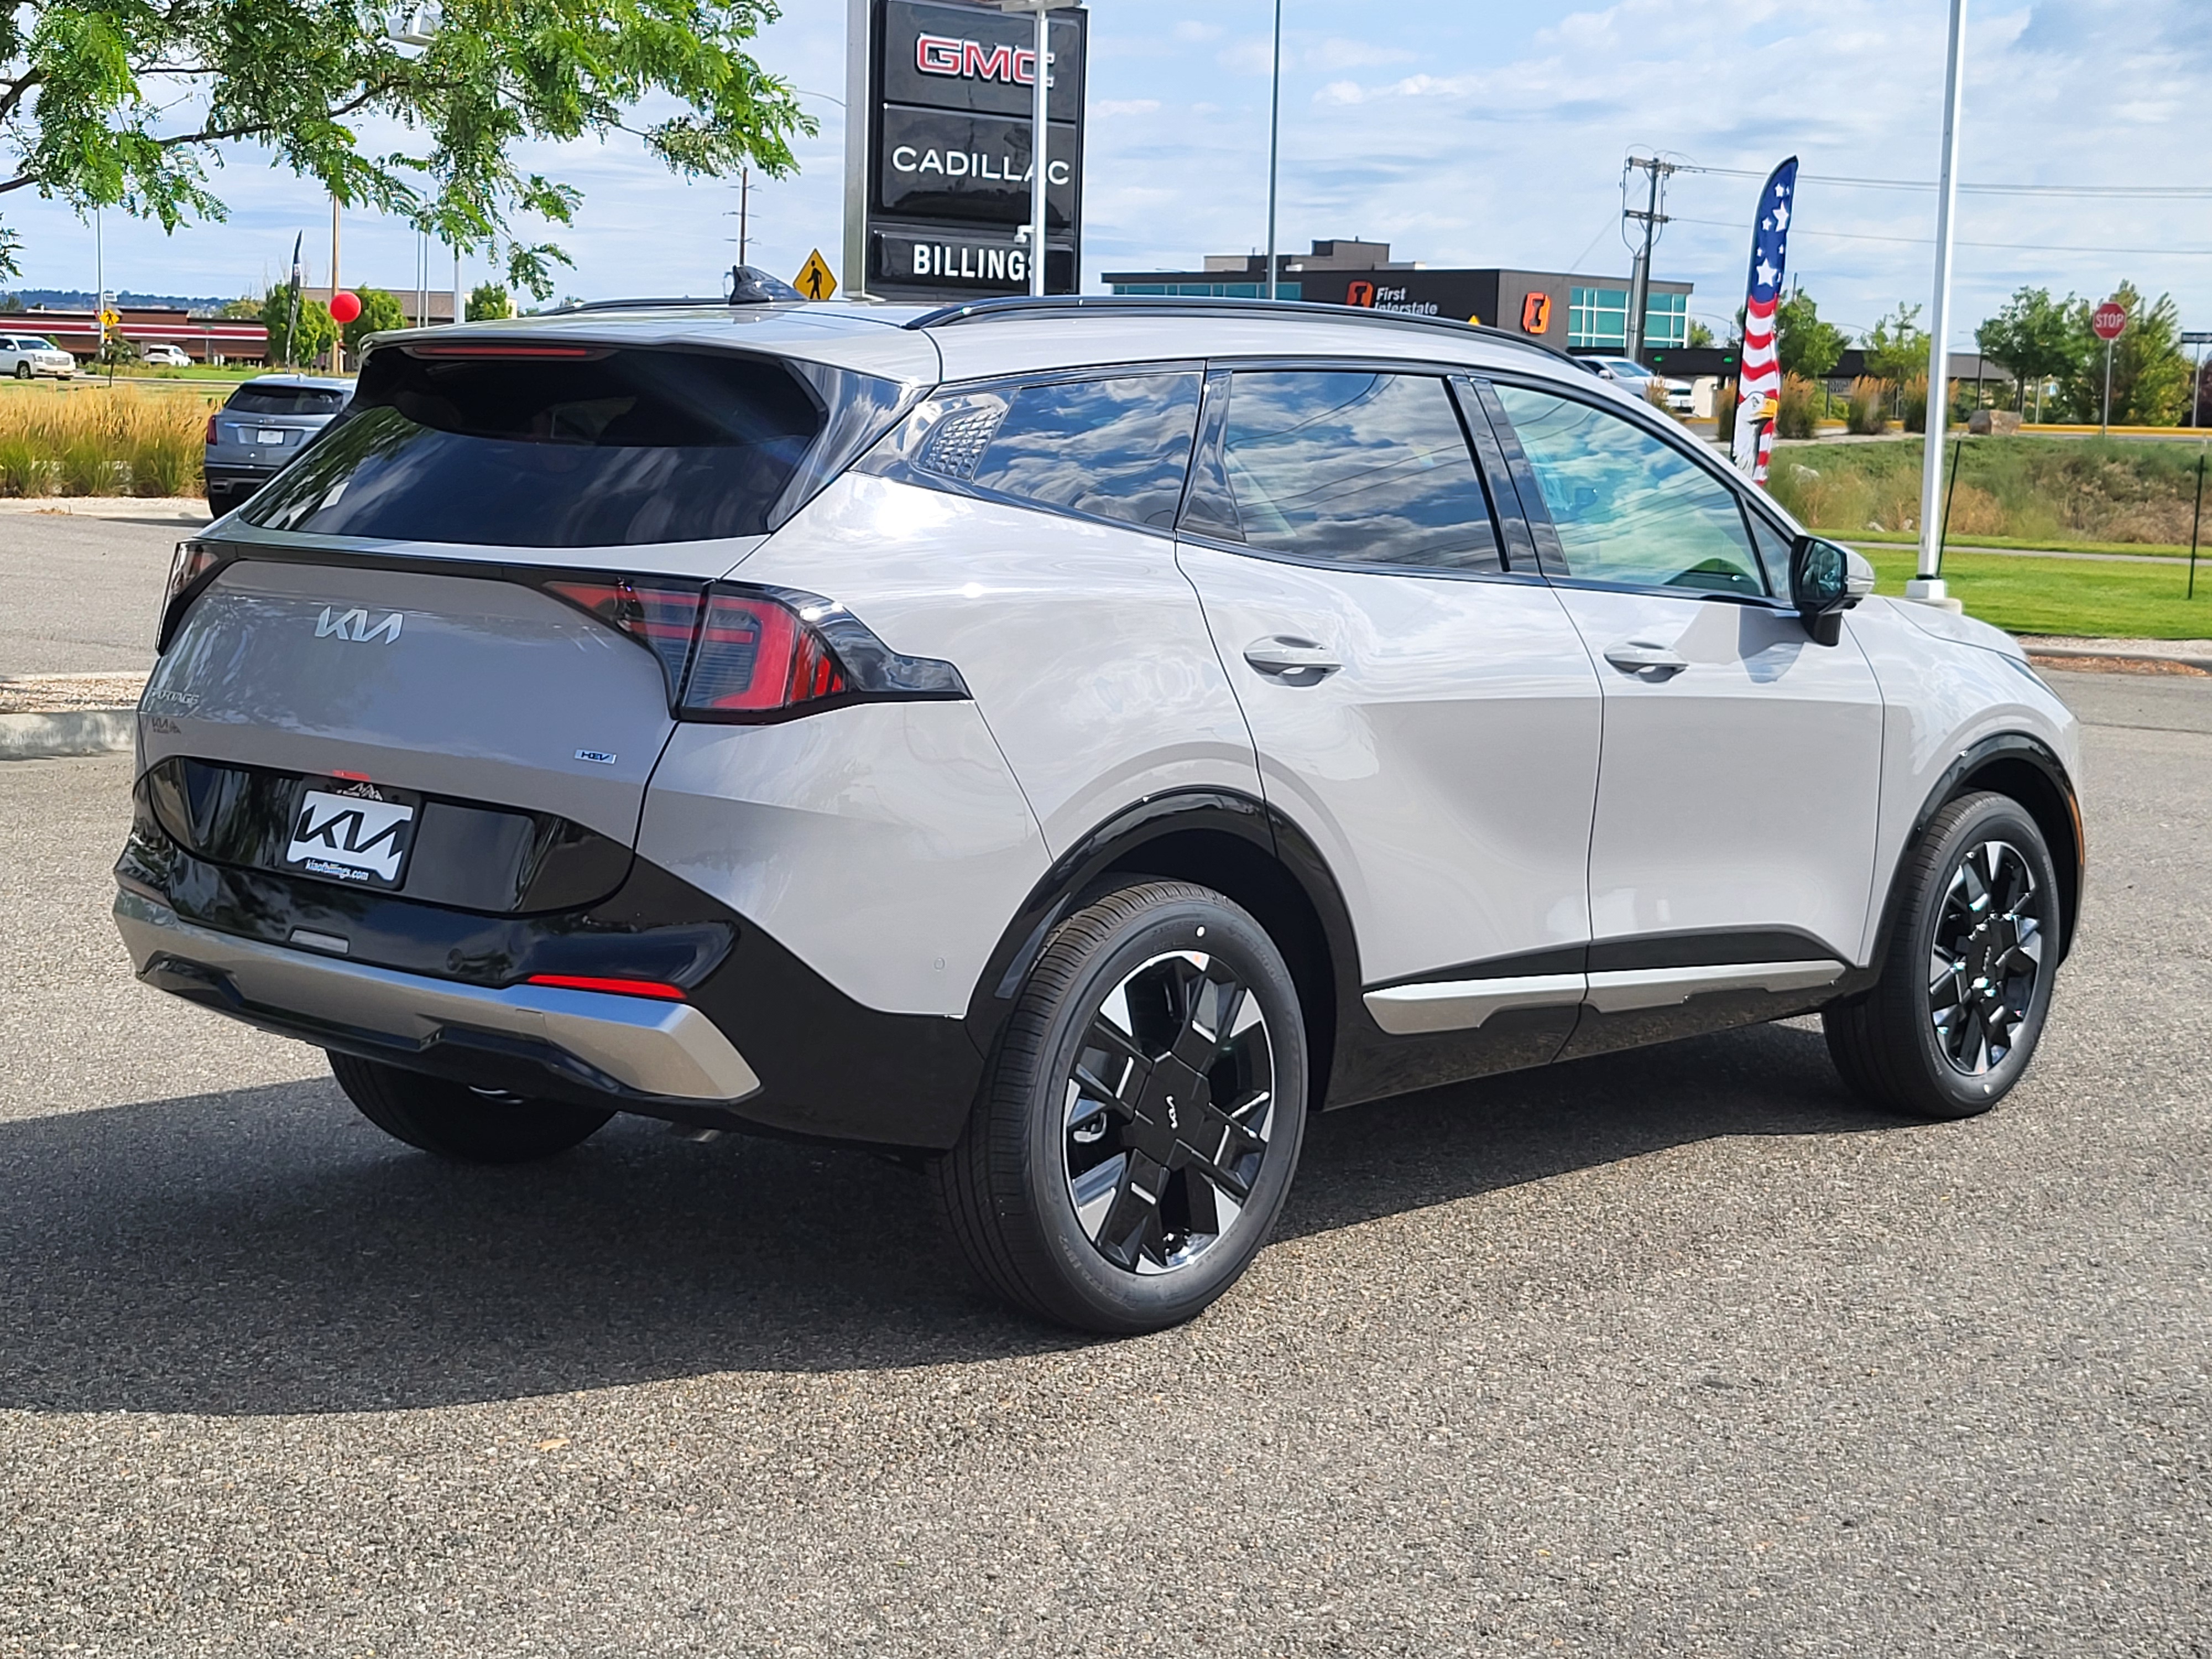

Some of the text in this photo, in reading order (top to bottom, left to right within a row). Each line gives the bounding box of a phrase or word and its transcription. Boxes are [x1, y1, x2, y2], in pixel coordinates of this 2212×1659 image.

[917, 34, 1055, 87] GMC
[913, 244, 1032, 281] BILLING
[1376, 287, 1406, 300] First
[2095, 313, 2124, 328] STOP
[314, 606, 404, 644] KIA
[294, 804, 413, 860] KIA
